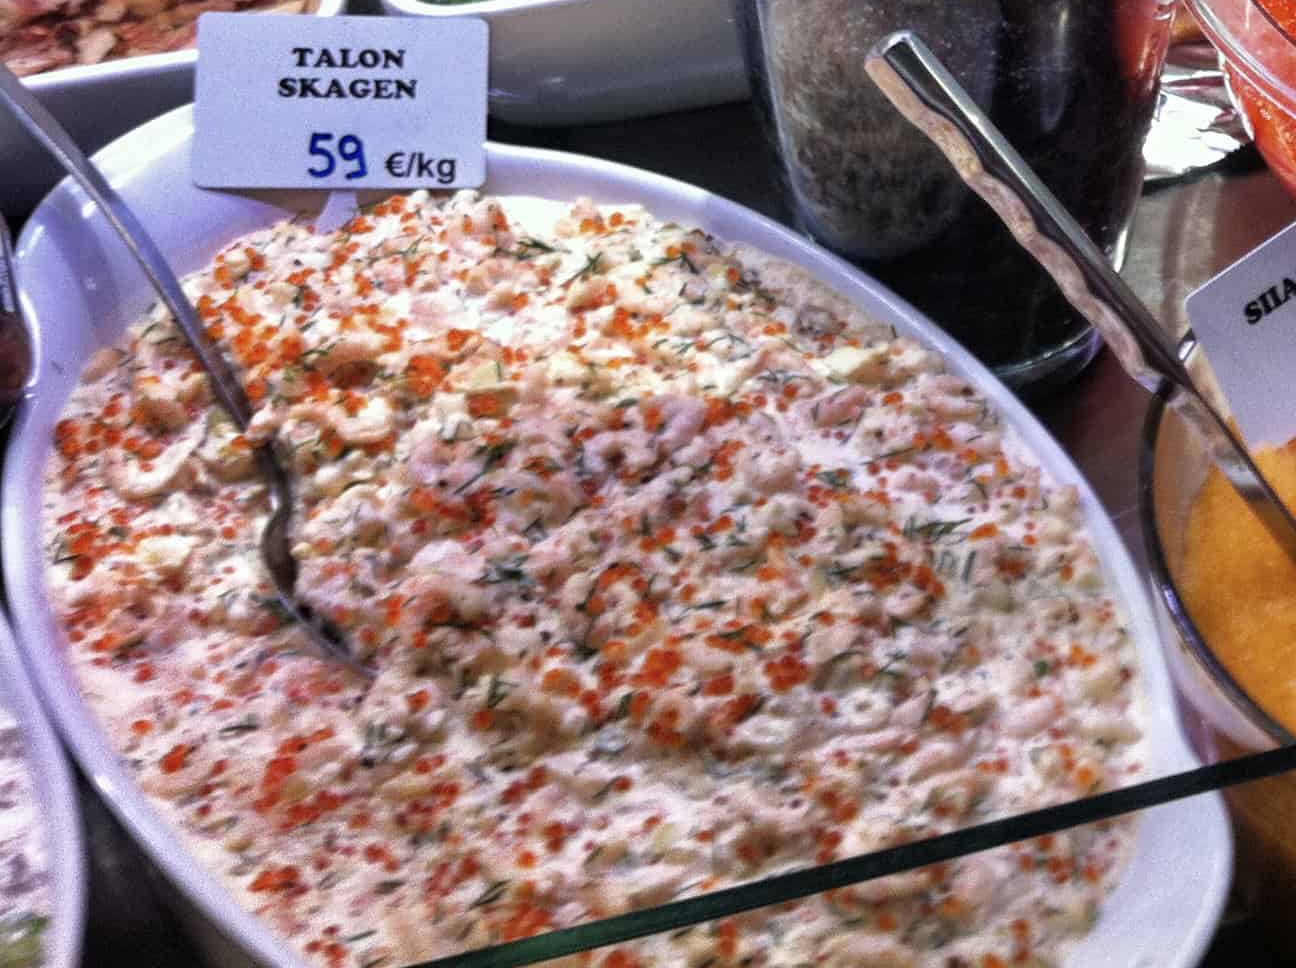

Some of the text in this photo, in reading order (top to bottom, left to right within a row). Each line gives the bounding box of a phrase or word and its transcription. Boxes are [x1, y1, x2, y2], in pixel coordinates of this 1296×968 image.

[292, 47, 406, 69] TALON
[277, 77, 417, 99] SKAGEN
[308, 132, 456, 183] 59 €/kg
